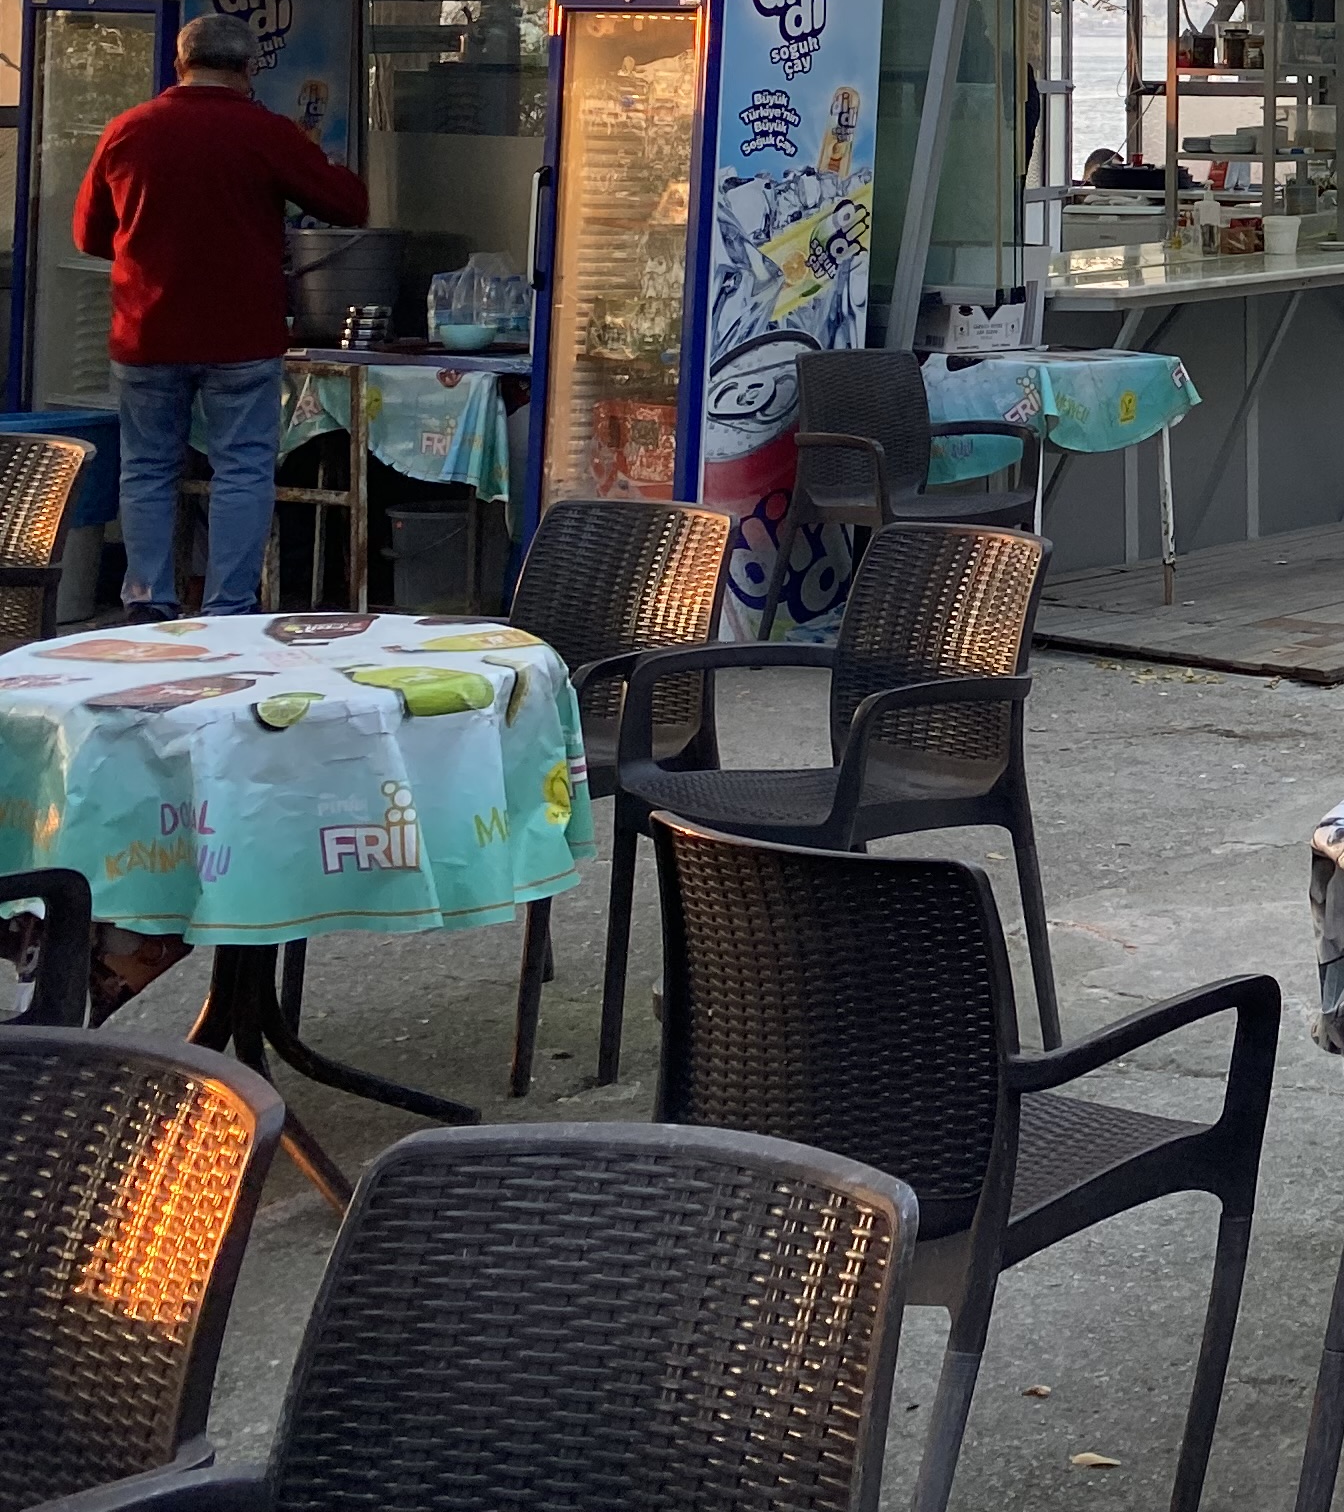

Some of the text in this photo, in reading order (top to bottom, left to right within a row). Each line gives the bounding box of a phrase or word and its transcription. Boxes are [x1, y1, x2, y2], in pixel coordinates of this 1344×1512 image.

[784, 54, 812, 81] çay
[753, 92, 790, 107] Büyük
[753, 120, 788, 135] Büyük
